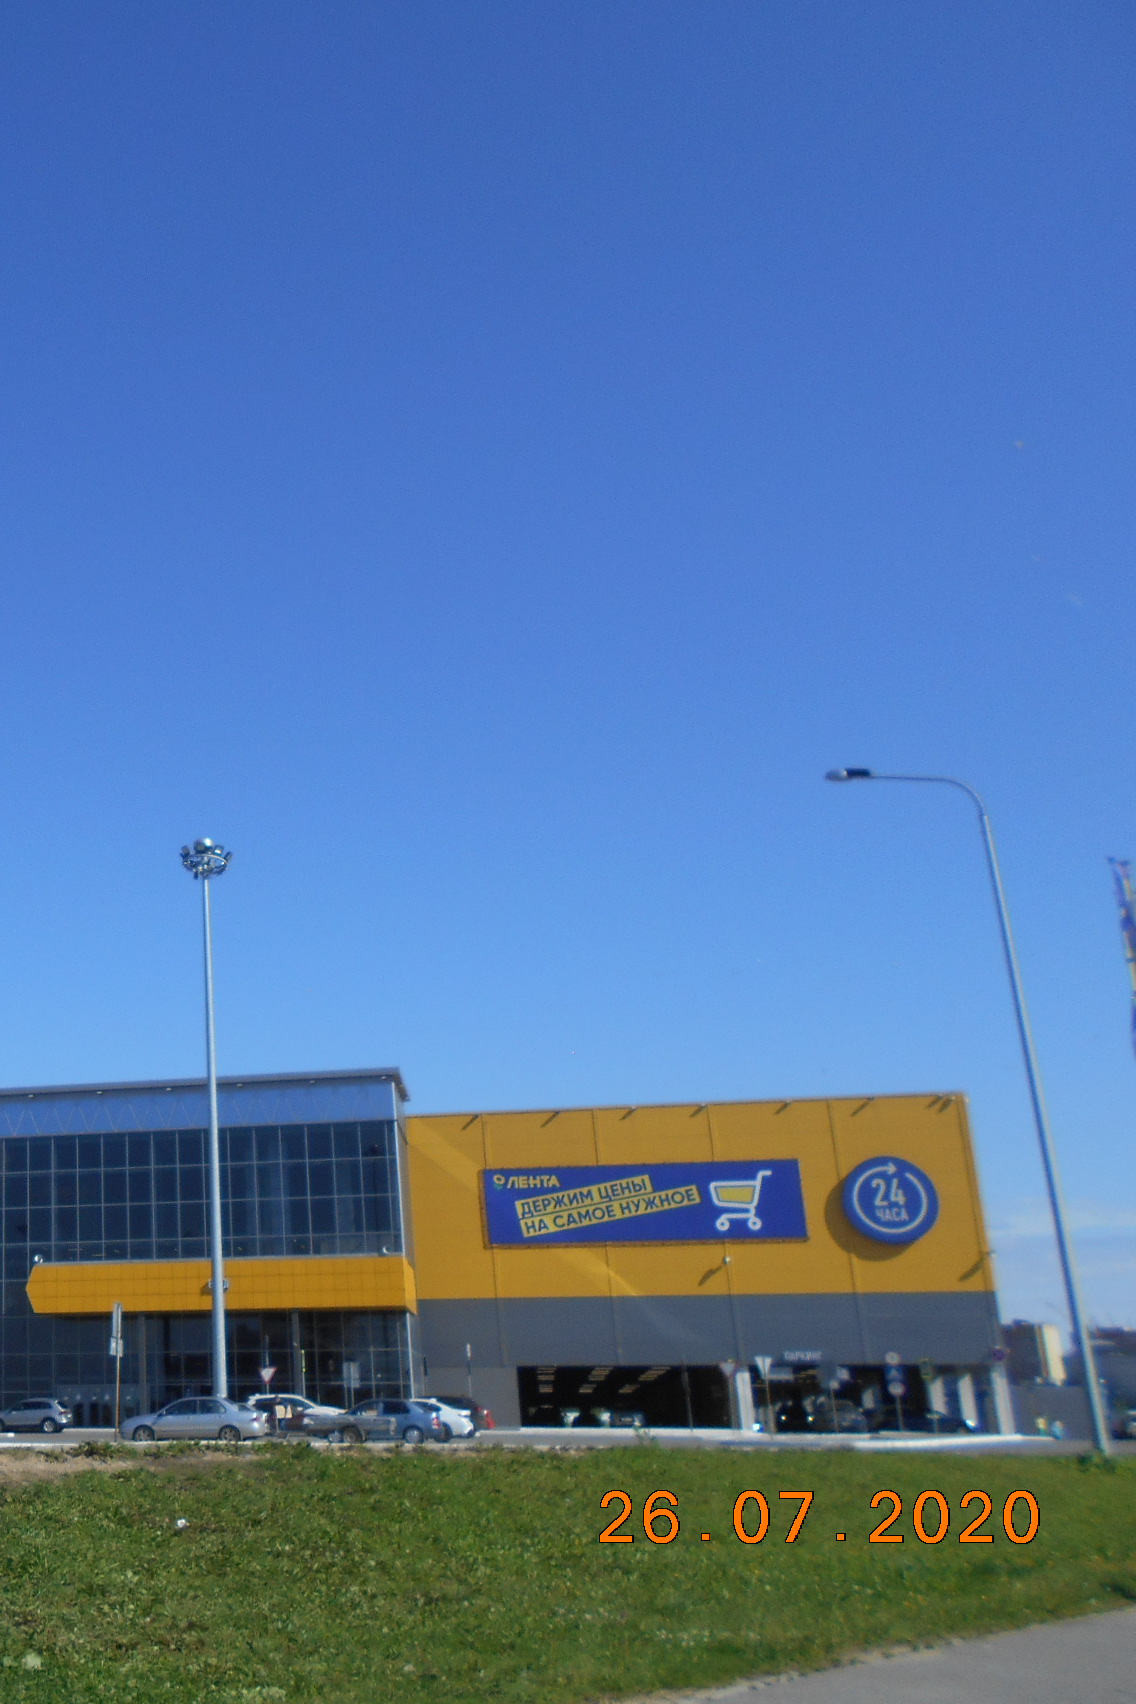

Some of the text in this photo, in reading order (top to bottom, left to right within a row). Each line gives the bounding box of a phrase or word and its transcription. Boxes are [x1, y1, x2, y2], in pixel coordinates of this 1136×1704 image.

[506, 1174, 560, 1189] ЛЕНТА
[871, 1178, 906, 1206] 24
[521, 1178, 649, 1218] ДЕРЖИМ ЦЕНЫ
[524, 1187, 697, 1235] НА САМОЕ НУЖНОЕ
[876, 1207, 909, 1221] ЧАСА
